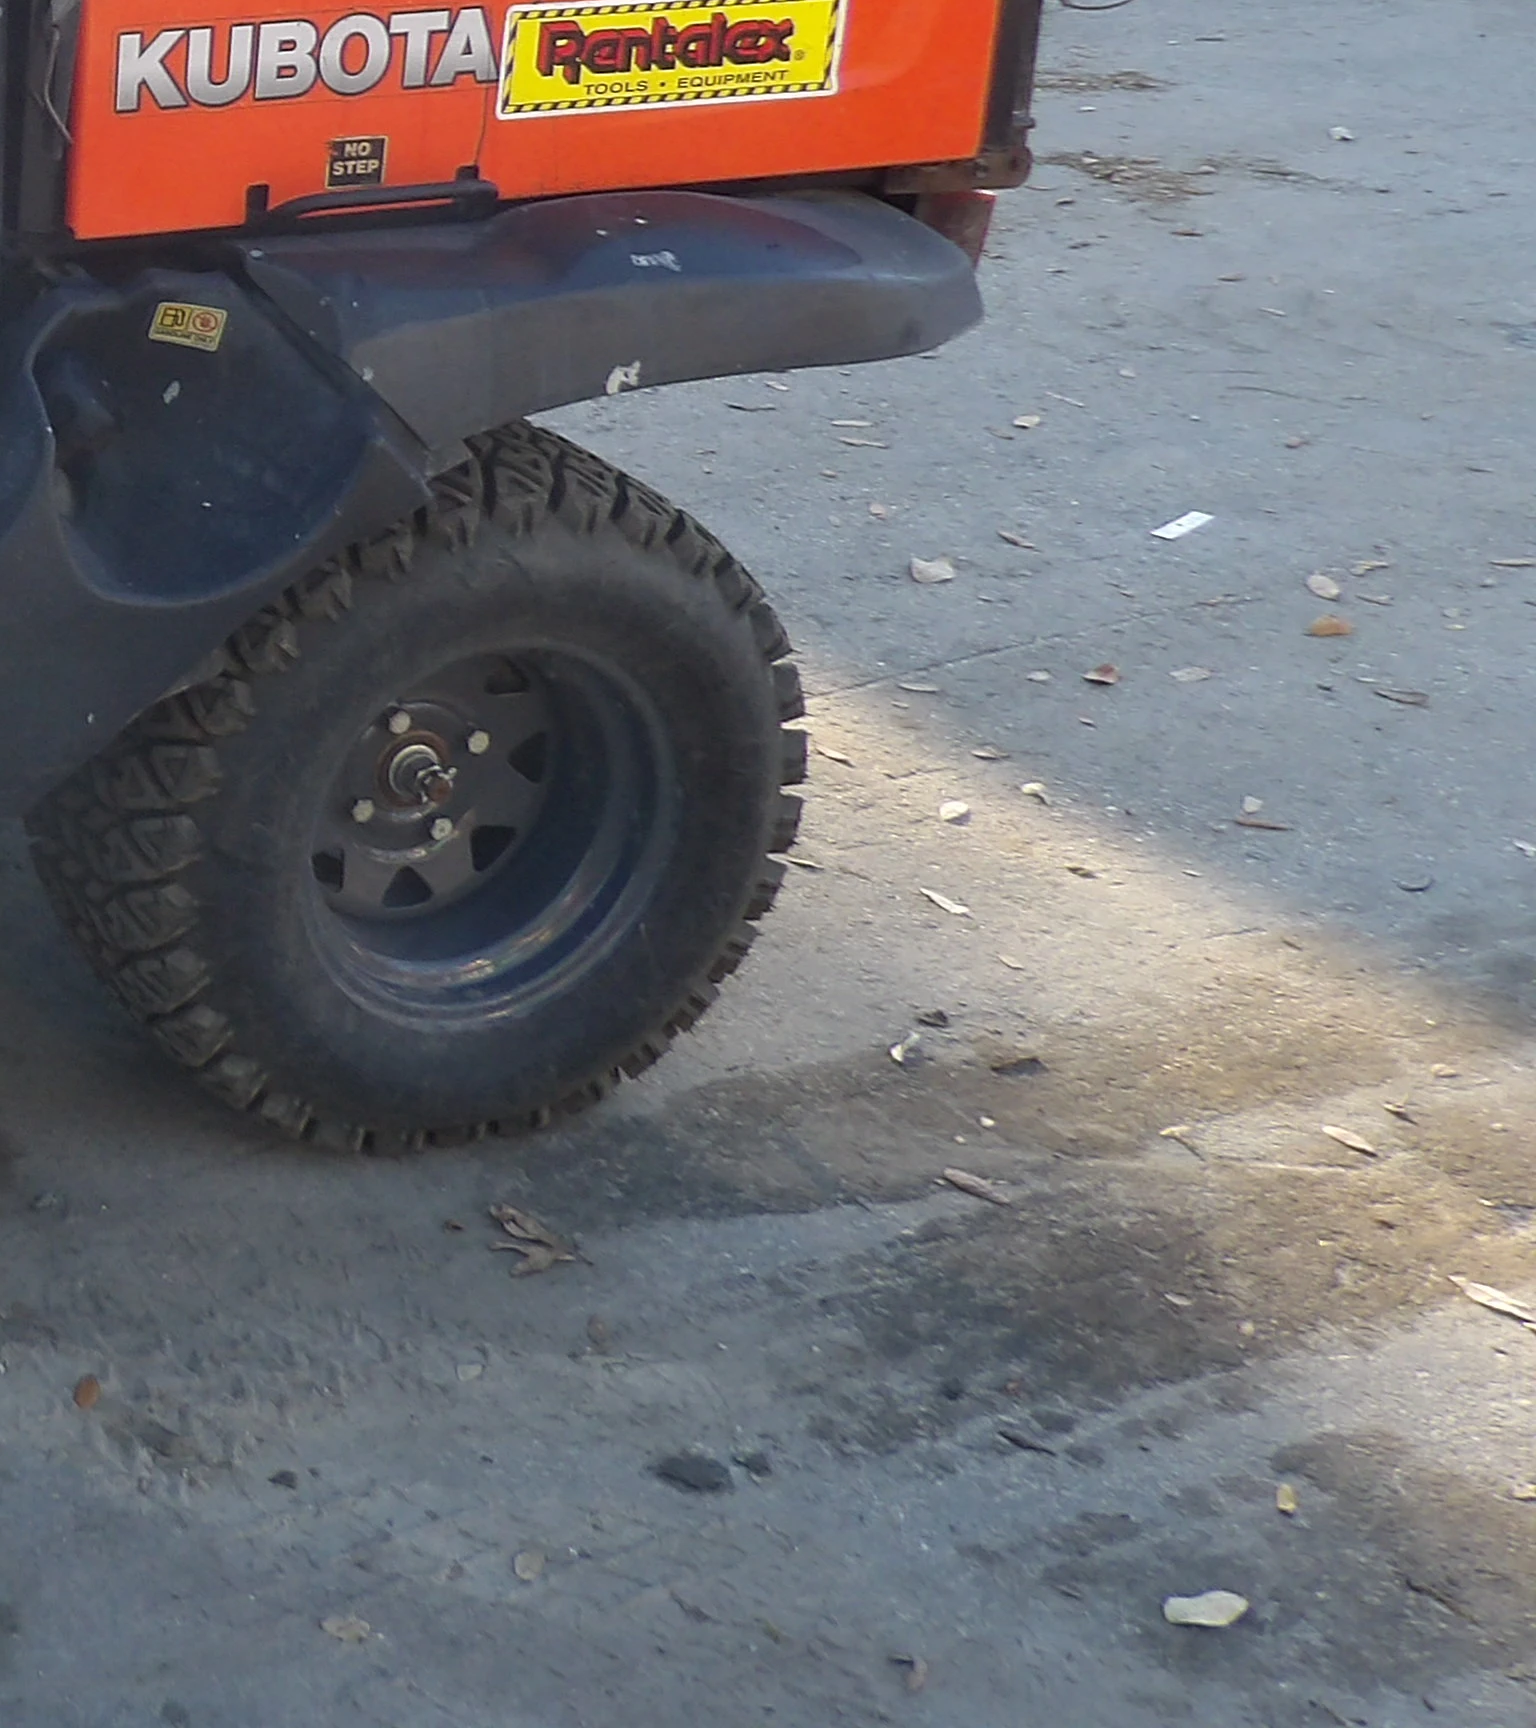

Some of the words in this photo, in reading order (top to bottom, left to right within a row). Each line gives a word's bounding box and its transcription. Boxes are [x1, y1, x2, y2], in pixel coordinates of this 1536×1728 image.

[114, 5, 499, 114] KUBOTA
[535, 12, 794, 85] Rentalex
[584, 80, 649, 96] TOOLS
[677, 70, 789, 89] EQUIPMENT
[344, 141, 371, 158] NO
[332, 159, 380, 176] STEP
